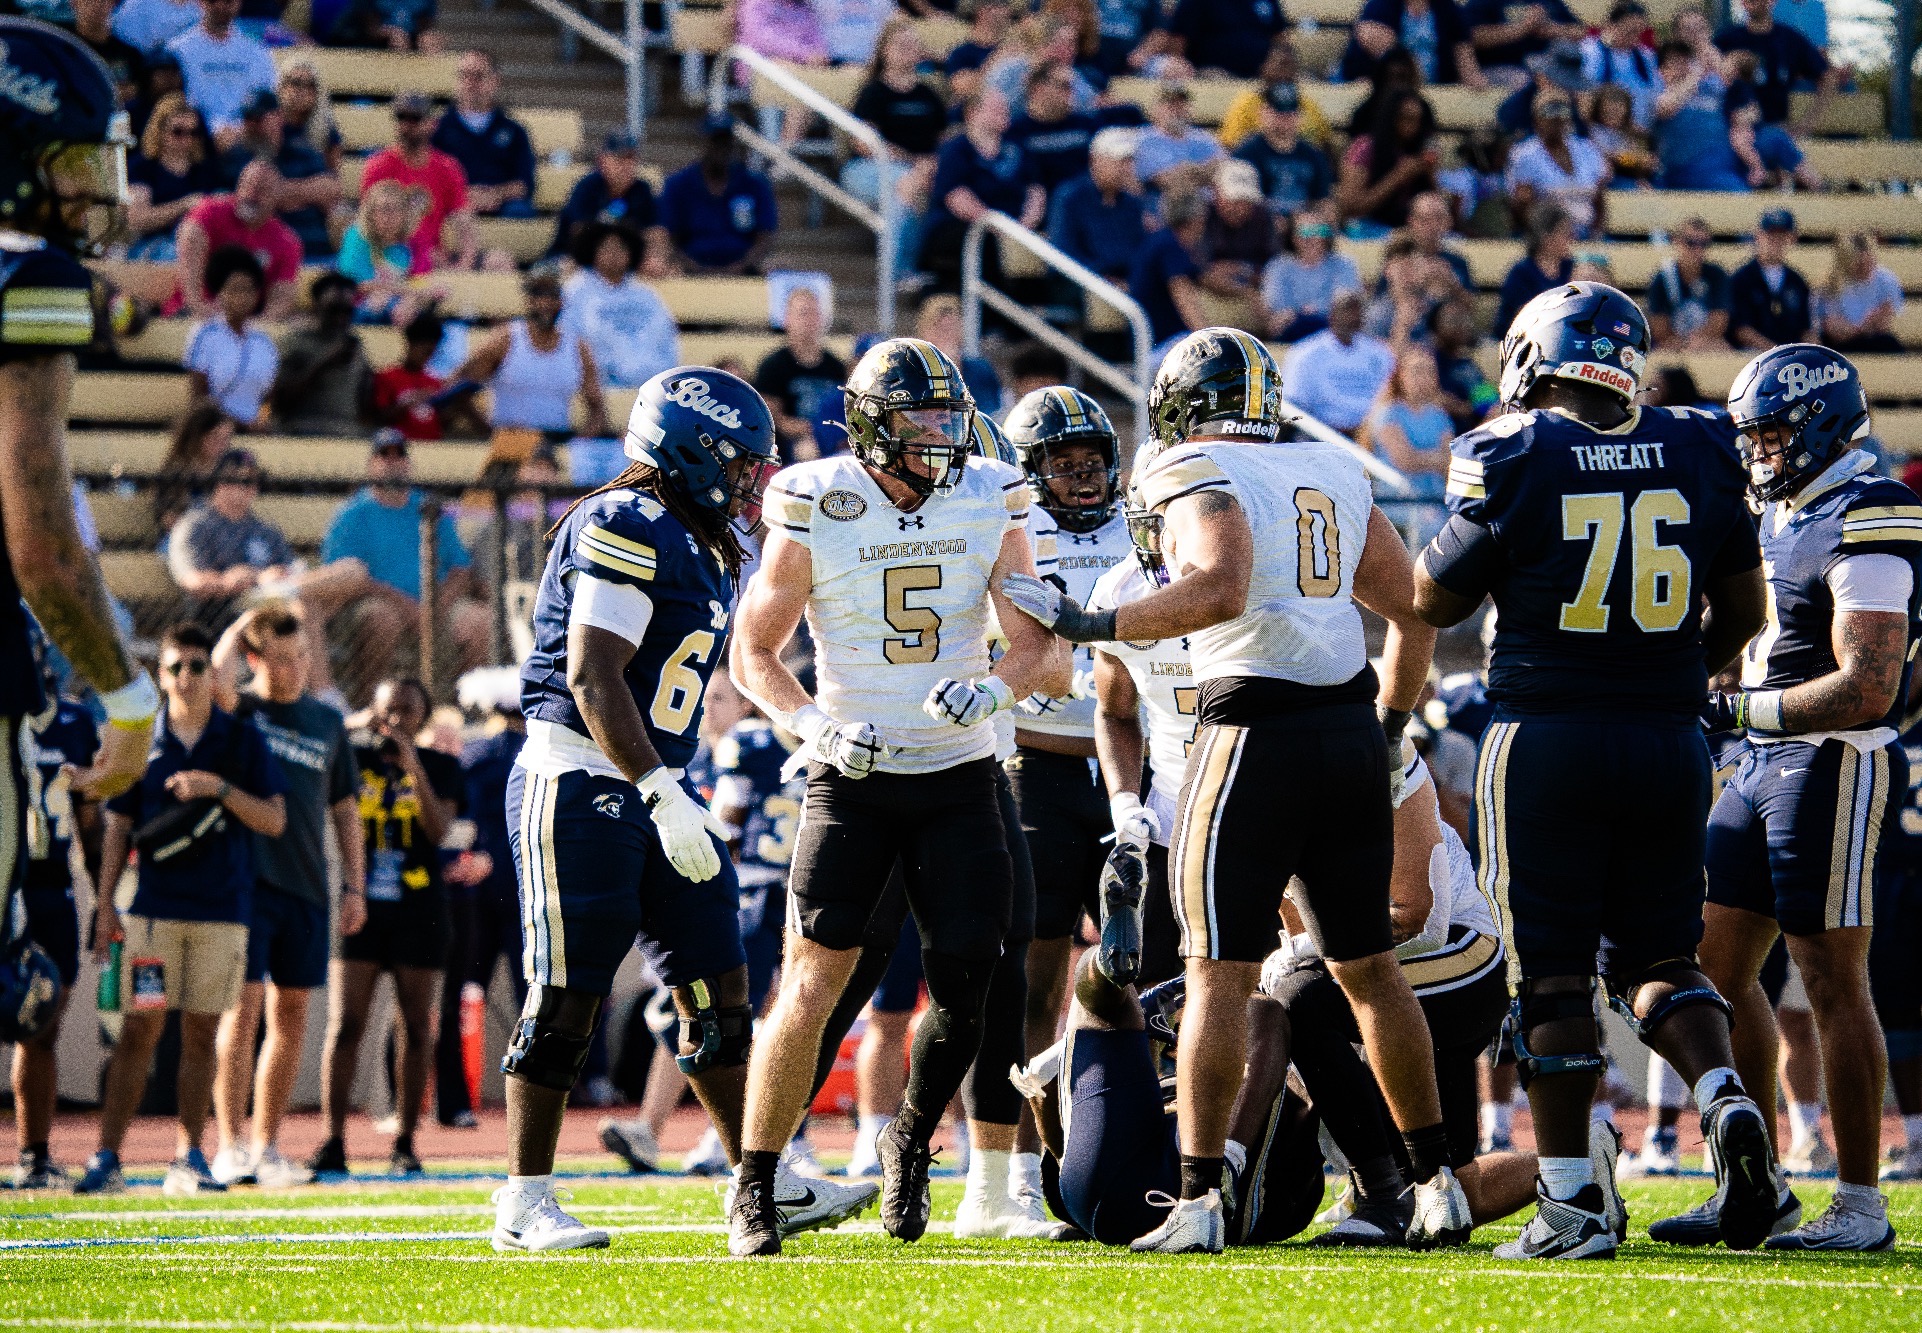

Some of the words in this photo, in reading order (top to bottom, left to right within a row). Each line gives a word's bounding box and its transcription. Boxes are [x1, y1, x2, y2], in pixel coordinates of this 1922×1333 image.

[1579, 363, 1633, 393] Riddell
[665, 377, 741, 429] Bucs
[1221, 420, 1277, 438] Riddell
[1570, 442, 1665, 472] THREATT
[859, 539, 967, 562] LINDENWOOD
[1293, 486, 1341, 598] 0
[1558, 488, 1692, 633] 76
[882, 565, 943, 665] 5
[1670, 988, 1709, 1001] DONJOY
[1565, 1059, 1601, 1067] DONJOY
